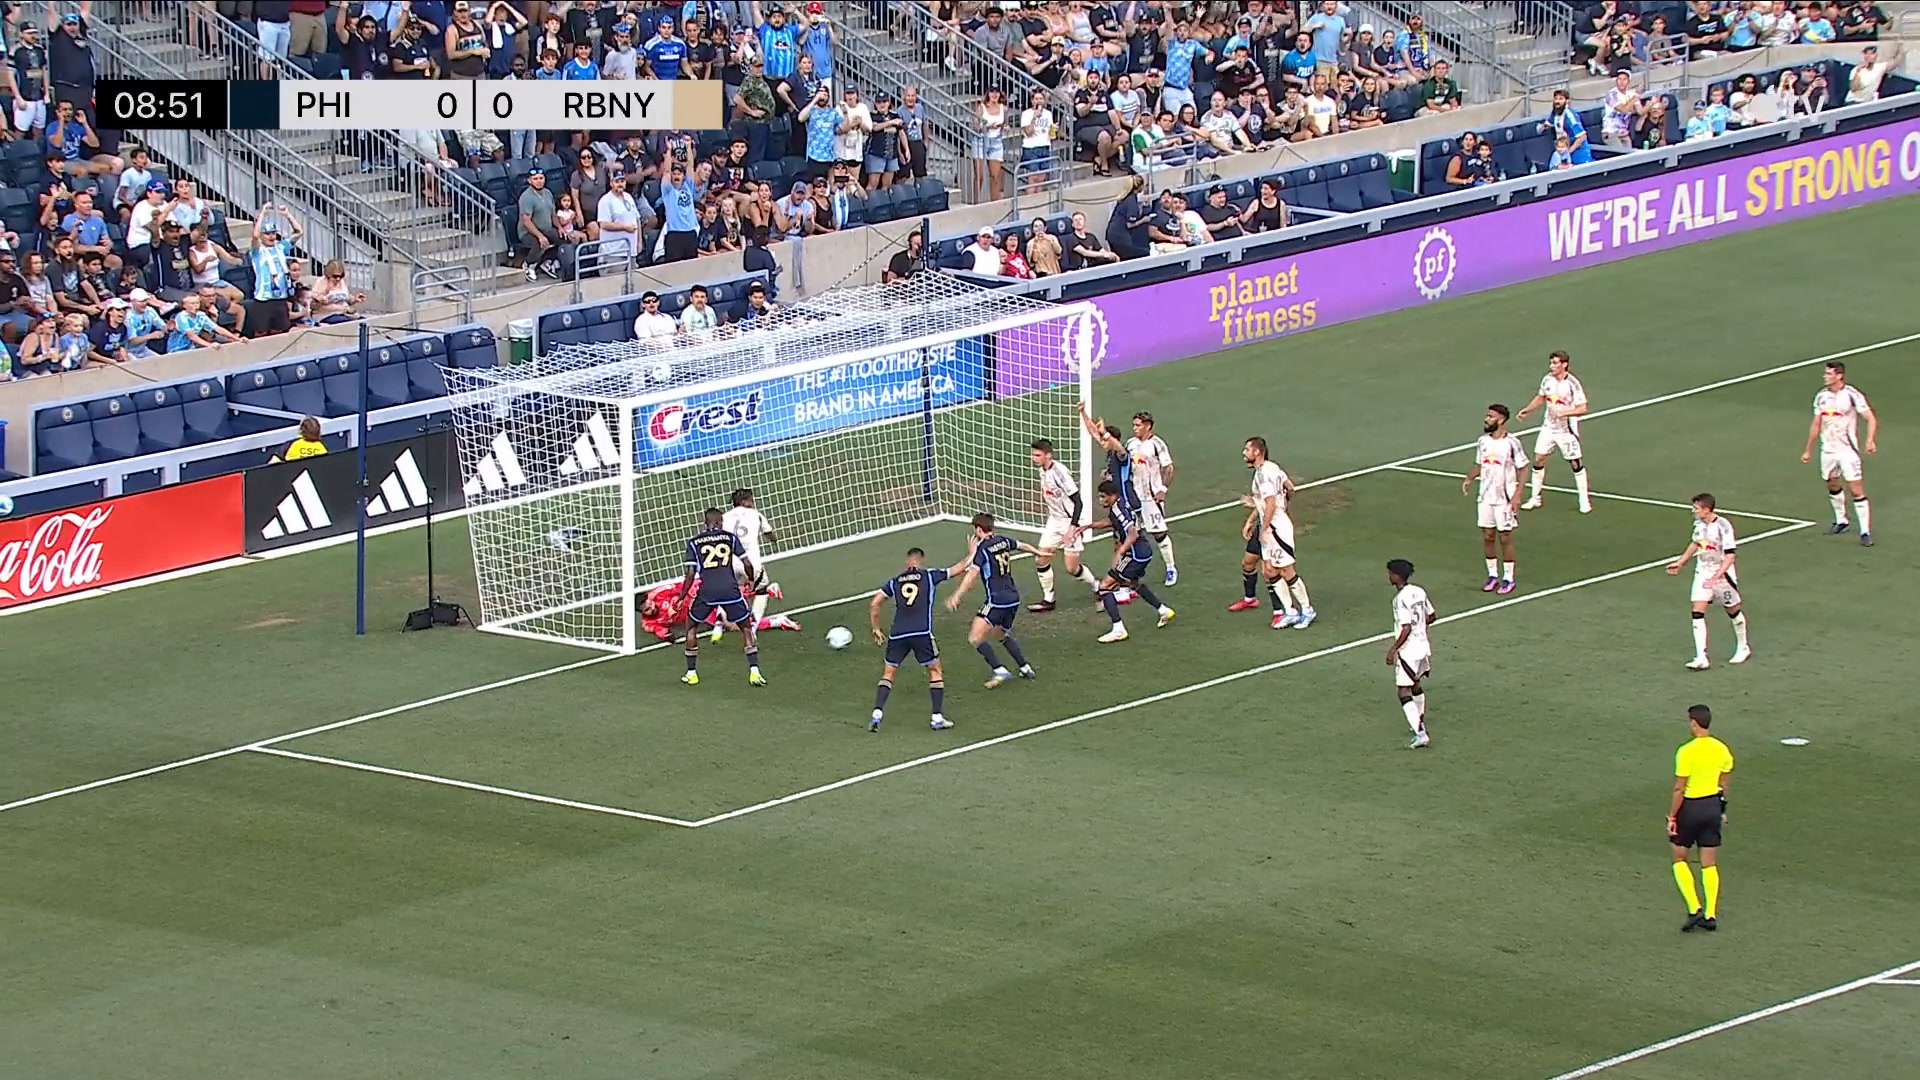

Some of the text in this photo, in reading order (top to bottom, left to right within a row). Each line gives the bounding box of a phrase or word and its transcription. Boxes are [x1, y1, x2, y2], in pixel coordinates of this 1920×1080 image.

[1548, 189, 1660, 261] WE'RE
[1668, 175, 1737, 235] ALL
[1745, 139, 1891, 216] STRONG
[1423, 248, 1446, 281] pf
[1209, 262, 1299, 321] planet
[1222, 299, 1317, 344] fitness
[794, 368, 828, 391] THE
[795, 373, 955, 423] BRAND IN AMERCA
[650, 390, 763, 441] Crest
[734, 520, 748, 538] 6
[1149, 513, 1161, 522] 19
[701, 543, 731, 569] 29
[1270, 548, 1284, 560] 42
[901, 582, 919, 606] 9
[1723, 590, 1732, 600] 8
